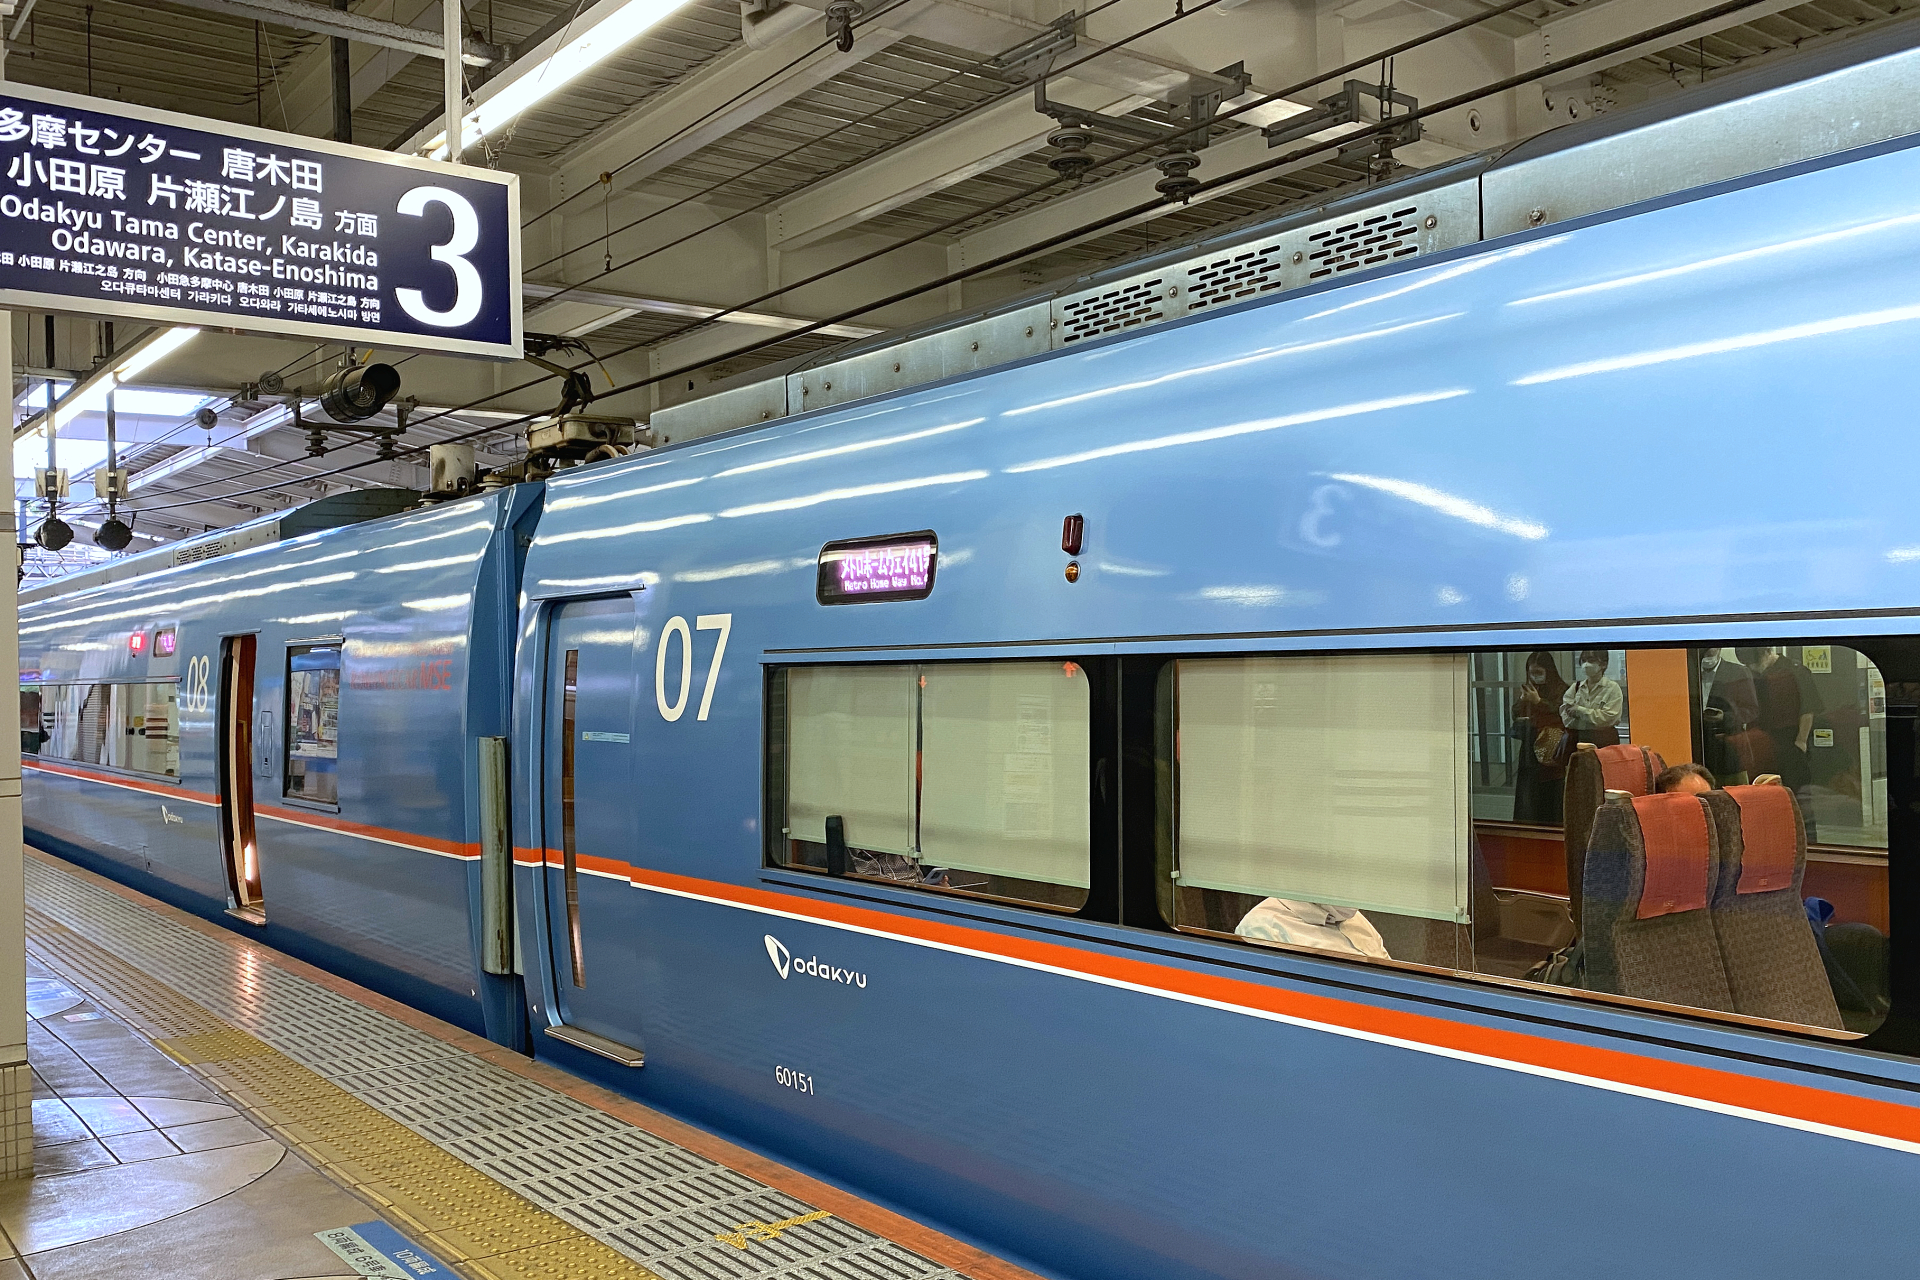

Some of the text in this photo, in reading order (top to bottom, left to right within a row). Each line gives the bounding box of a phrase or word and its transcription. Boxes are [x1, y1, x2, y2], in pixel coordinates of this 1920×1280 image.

[0, 107, 323, 193] 多摩センター 唐木田
[7, 152, 378, 238] 小田原 片瀬江ノ島 方面
[0, 194, 378, 267] Odakyu Tama Center, Karakida
[51, 228, 378, 291] Odawara, Katase-Enoshima
[395, 186, 483, 327] 3
[0, 252, 14, 265] 田
[17, 254, 55, 271] 小田原
[122, 268, 147, 281] 方向
[157, 272, 234, 292] 小田急多摩中心
[237, 282, 269, 296] 唐木田
[273, 287, 304, 300] 小田原
[360, 298, 380, 310] 方向
[100, 280, 381, 323] 오다큐타마센터 가라키다 오다와라 가타세에노시마 방면
[844, 579, 868, 591] Metro
[870, 577, 889, 589] Home
[892, 575, 907, 588] Way
[187, 655, 209, 713] 08
[421, 659, 452, 690] MSE
[655, 613, 732, 722] 07
[793, 955, 867, 989] odakyu
[775, 1065, 814, 1096] 60151
